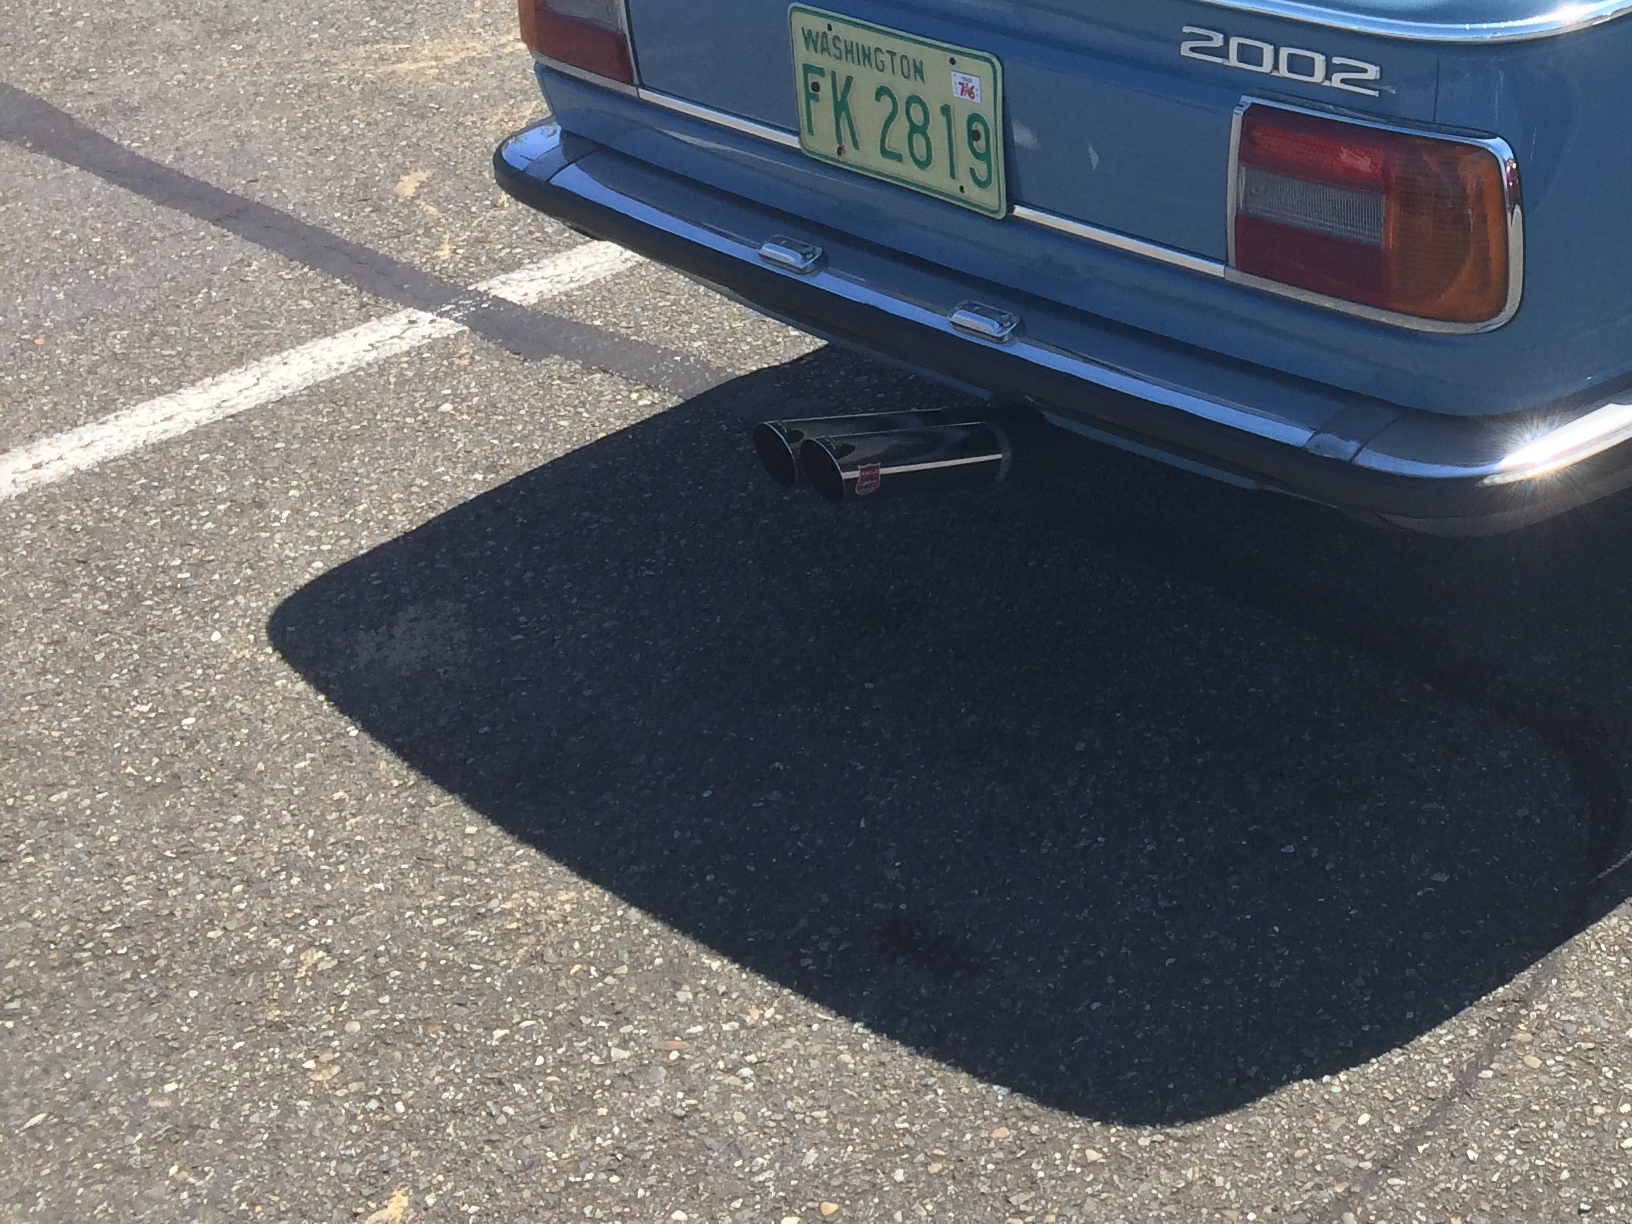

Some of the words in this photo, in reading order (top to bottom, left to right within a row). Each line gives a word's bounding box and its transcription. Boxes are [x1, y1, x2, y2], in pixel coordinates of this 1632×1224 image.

[801, 26, 926, 84] WASHINGTON
[1180, 25, 1381, 98] 2002
[802, 62, 860, 151] FK
[874, 84, 993, 190] 2819
